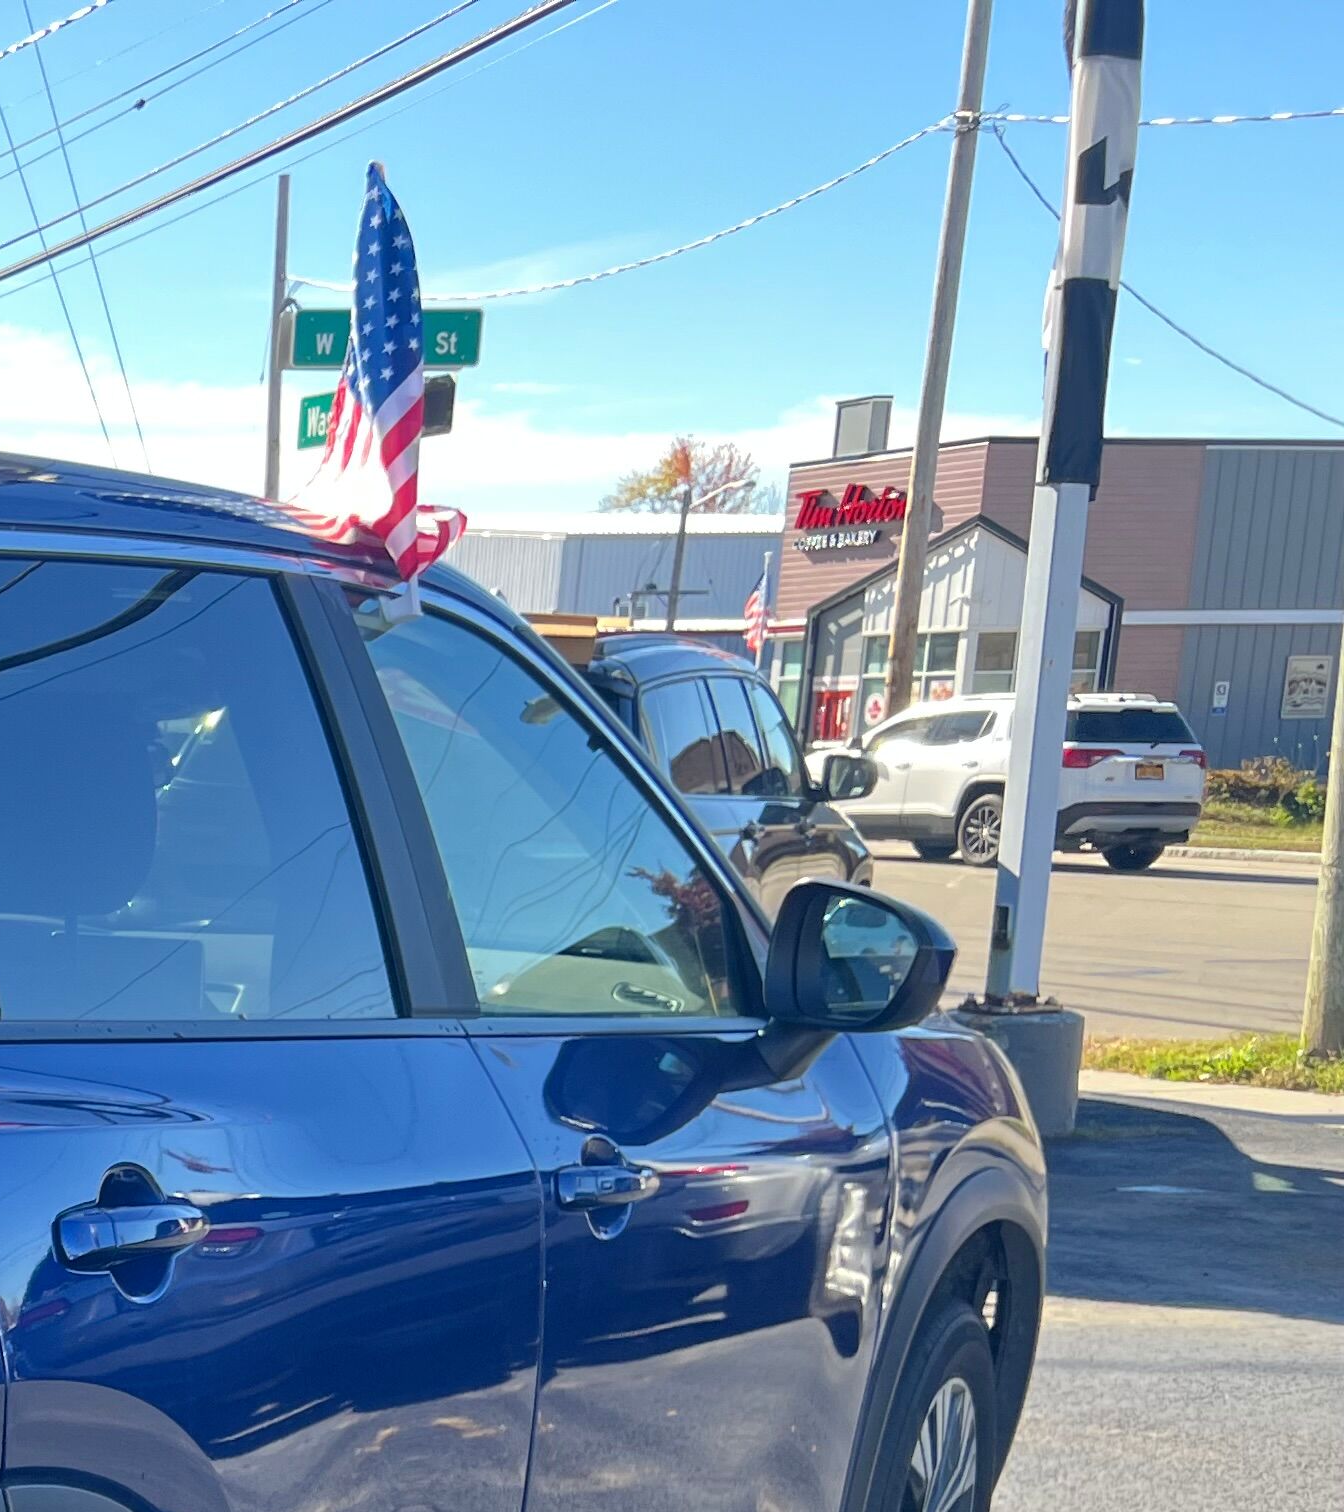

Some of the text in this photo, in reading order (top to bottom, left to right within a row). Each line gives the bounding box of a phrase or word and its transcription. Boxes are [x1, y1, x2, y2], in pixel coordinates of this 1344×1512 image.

[316, 331, 458, 355] W St
[794, 483, 907, 529] Tim Horton
